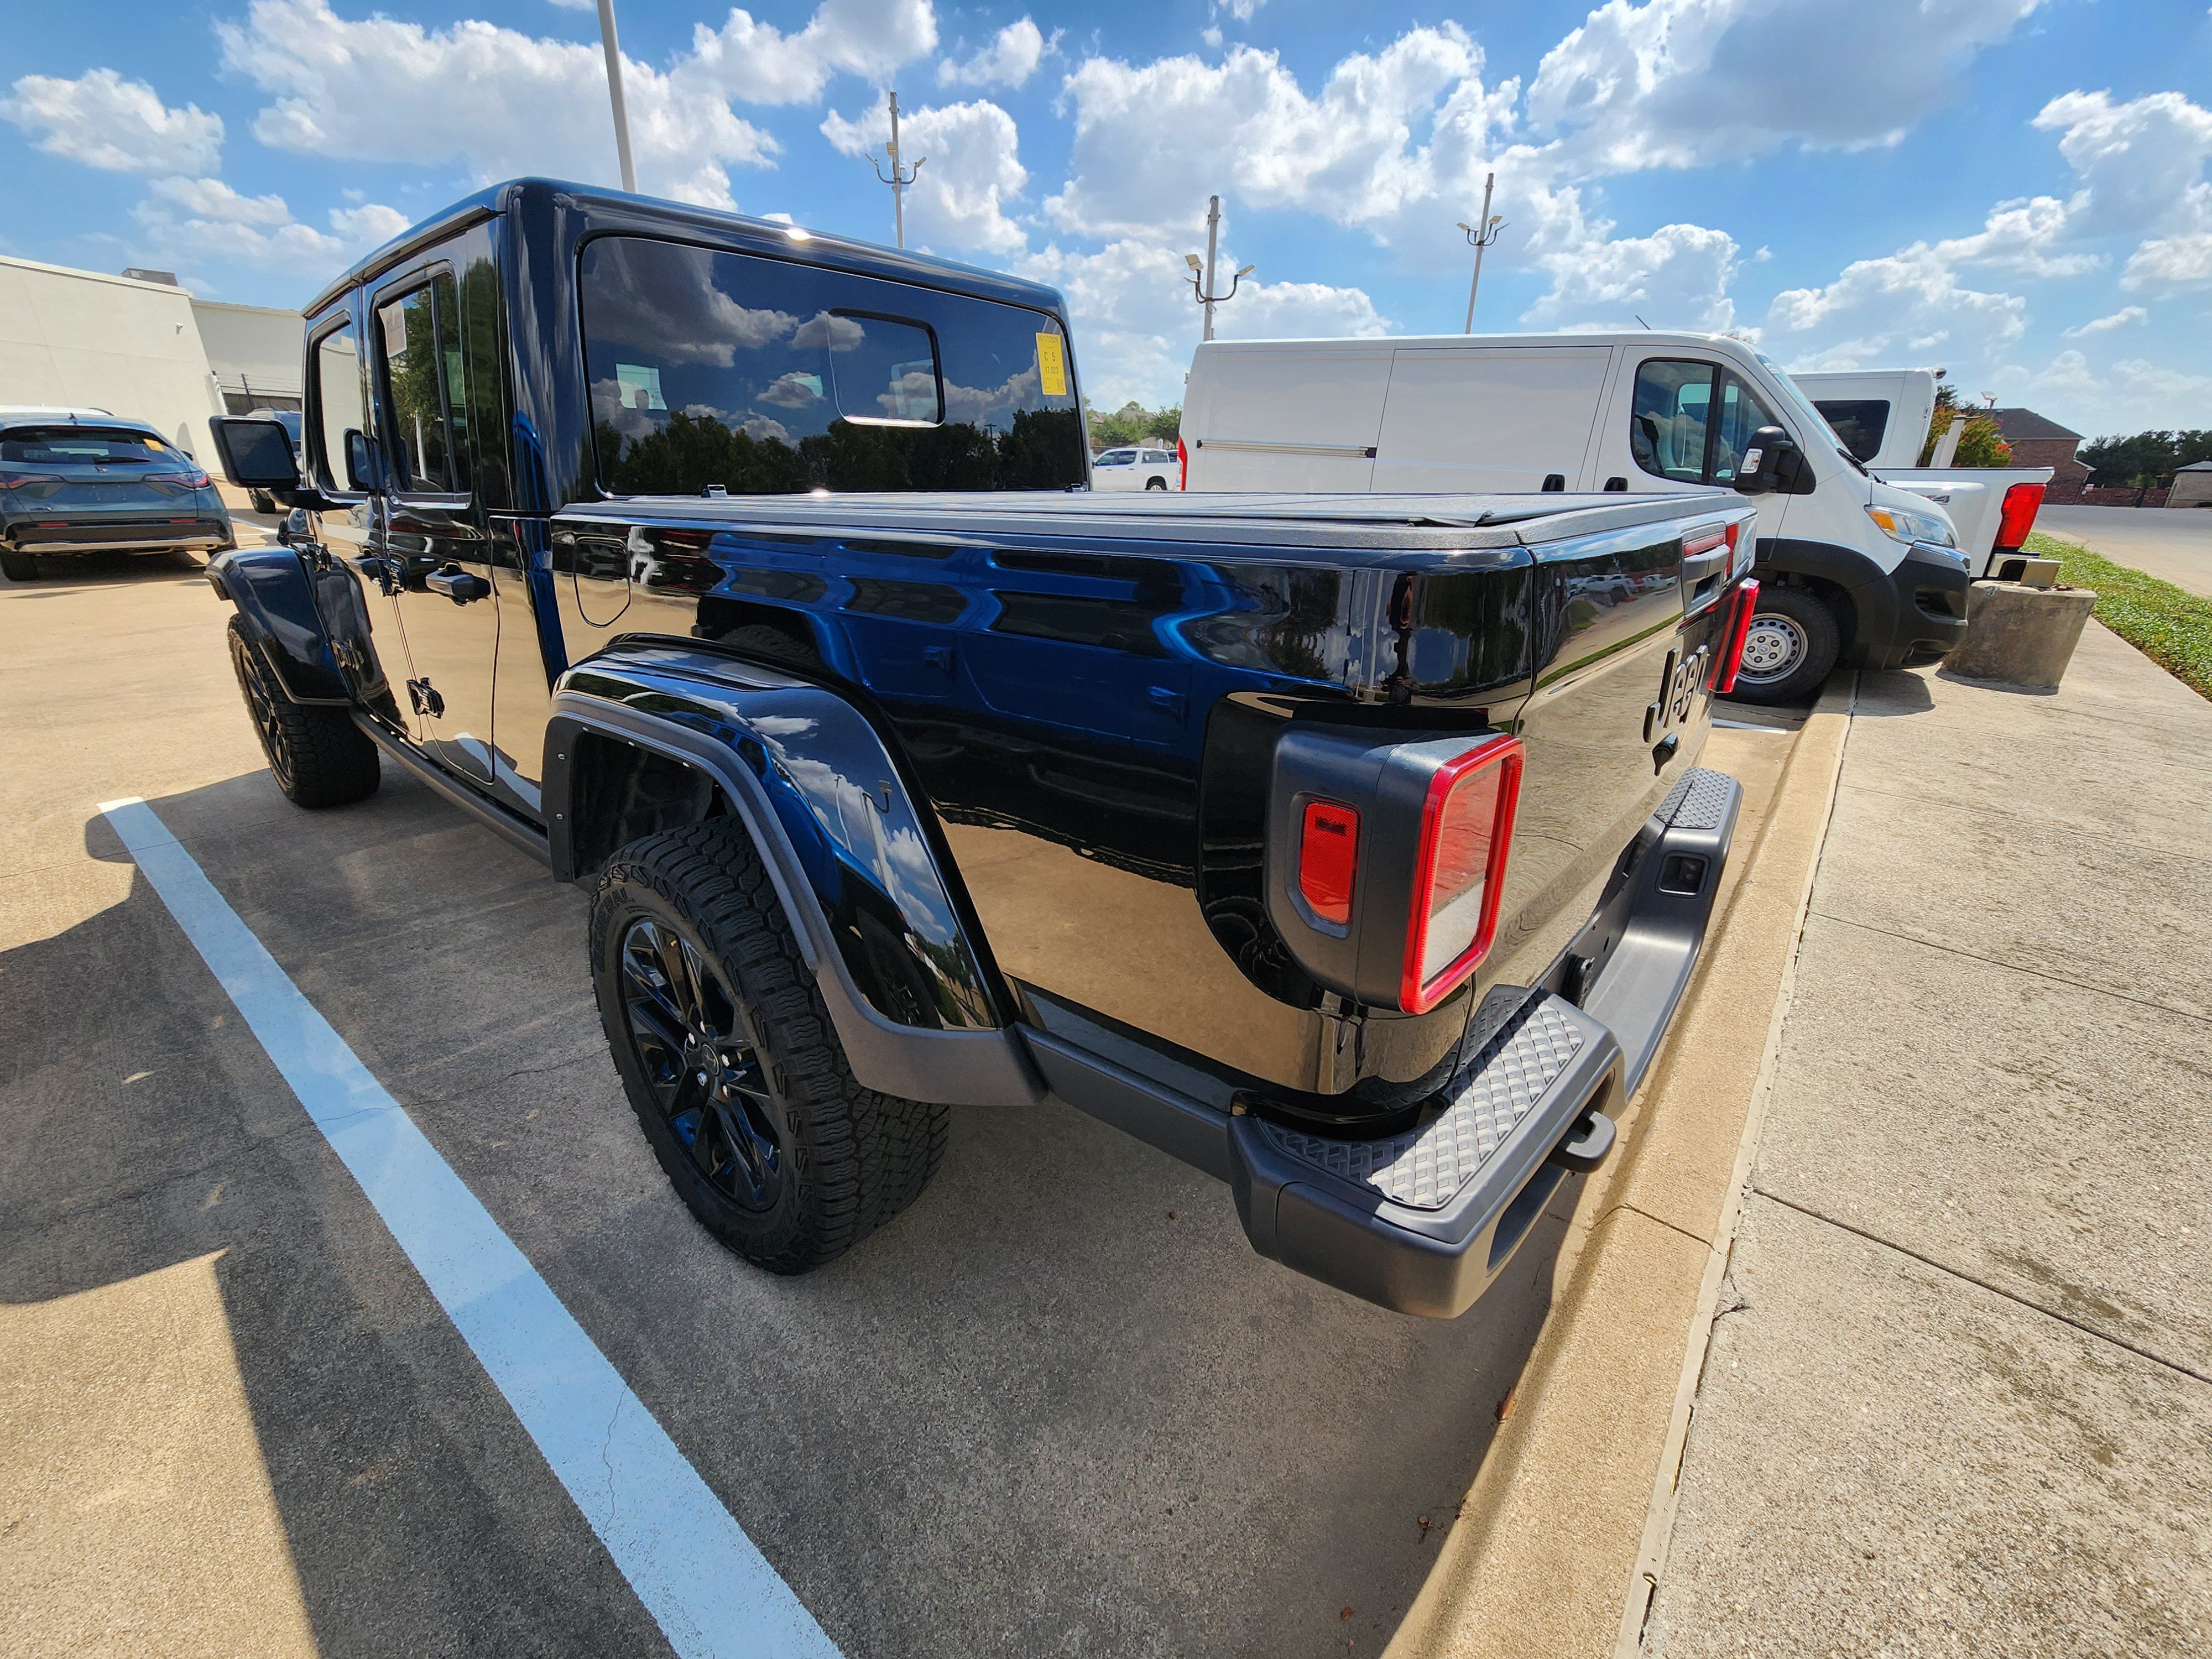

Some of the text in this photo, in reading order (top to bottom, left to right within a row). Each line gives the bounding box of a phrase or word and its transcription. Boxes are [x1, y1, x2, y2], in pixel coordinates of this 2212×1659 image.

[1044, 351, 1056, 362] C 5
[1642, 643, 1708, 743] Jeep
[593, 887, 635, 973] GENERAL
